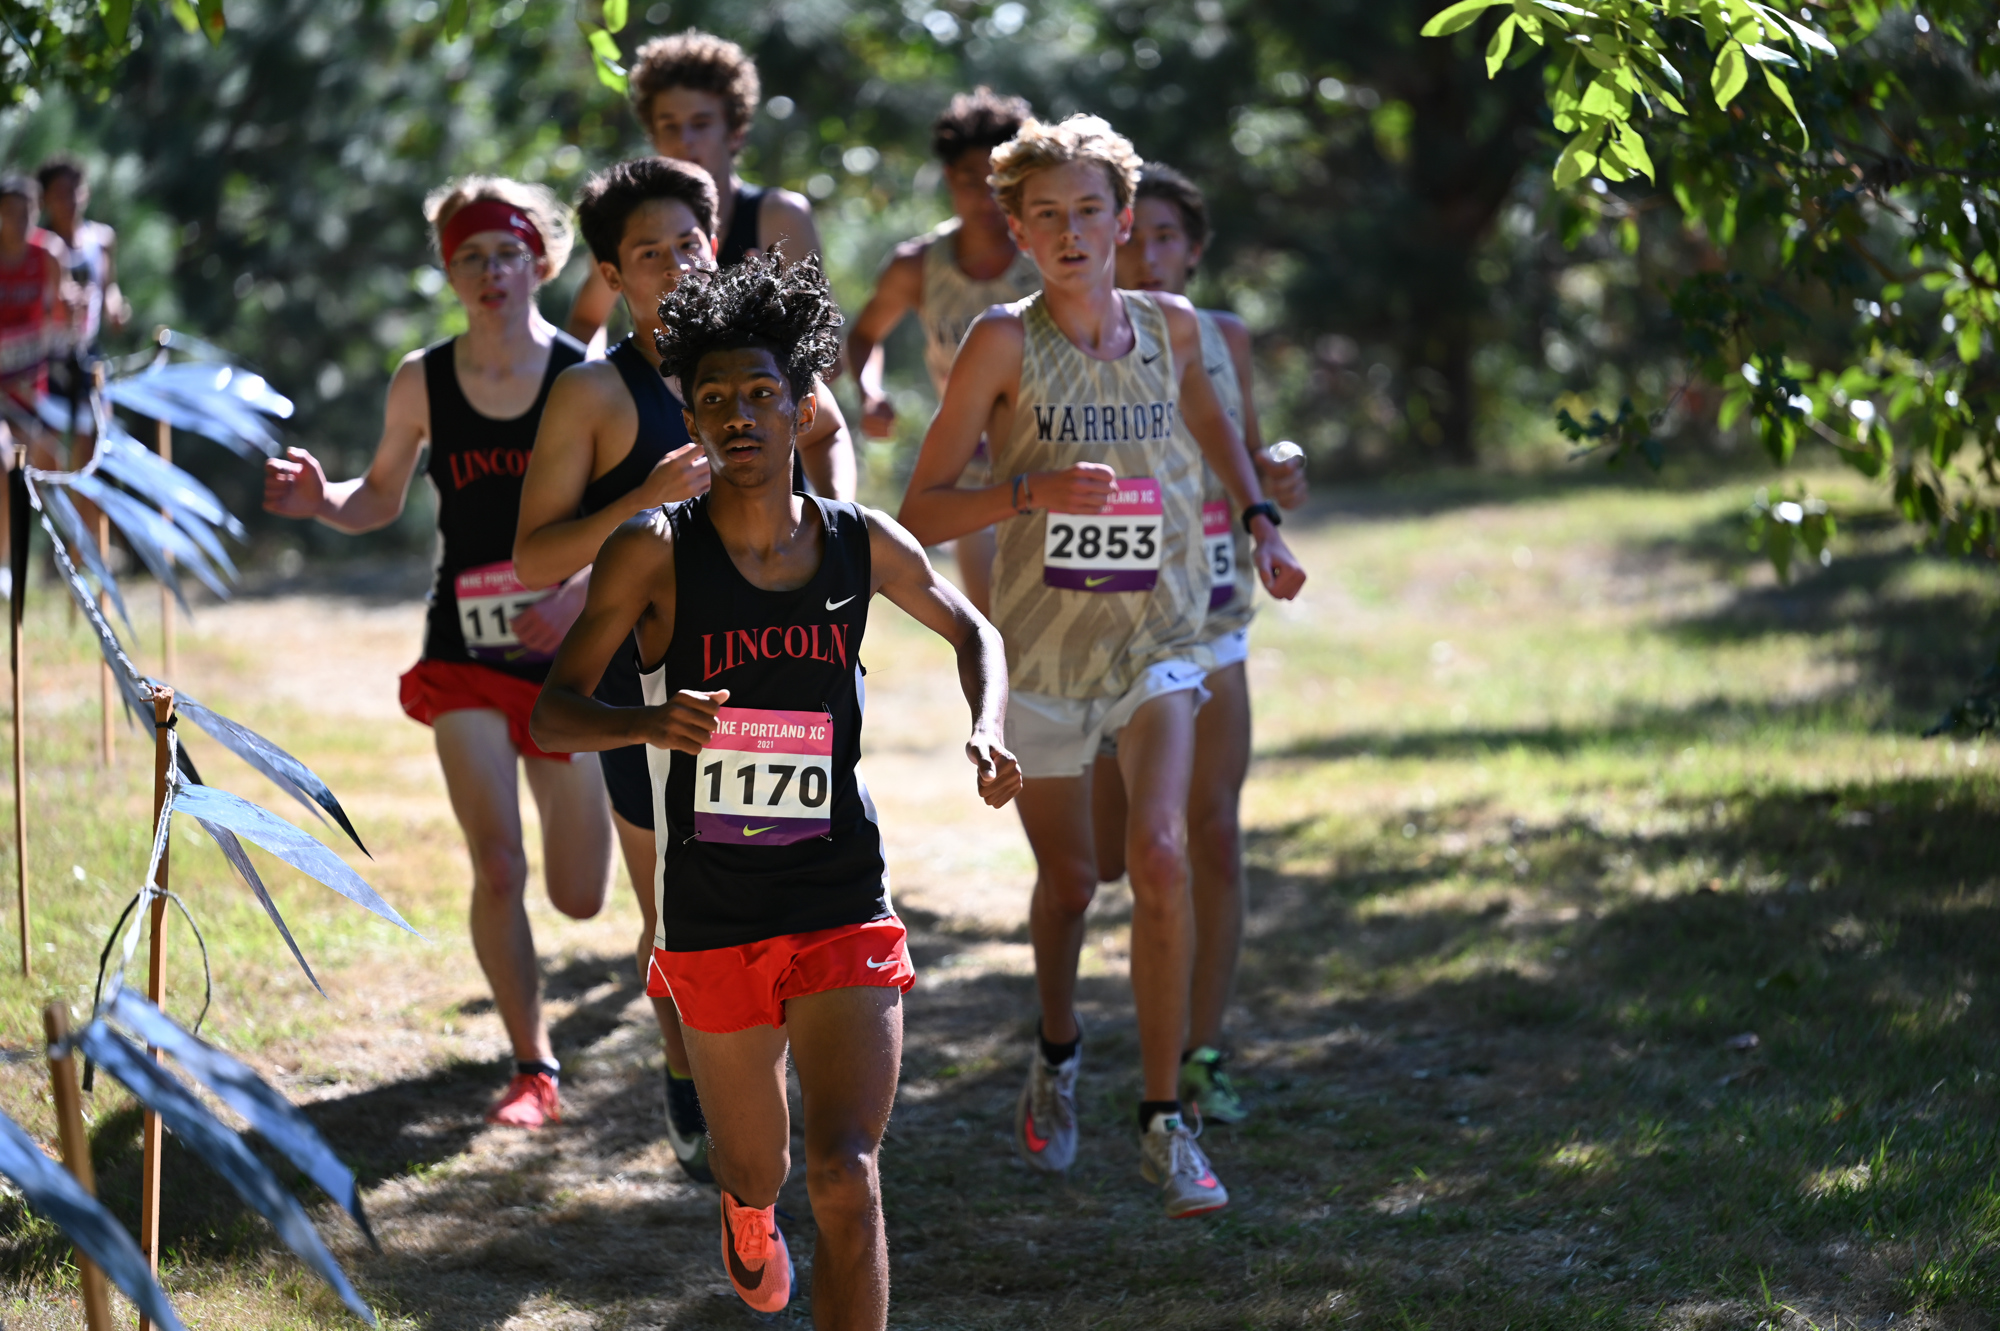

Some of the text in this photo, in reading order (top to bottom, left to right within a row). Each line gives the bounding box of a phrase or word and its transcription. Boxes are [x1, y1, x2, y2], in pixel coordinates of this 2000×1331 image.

[449, 446, 533, 490] LINCO
[1049, 523, 1157, 560] 2853
[701, 624, 849, 682] LINCOLN
[712, 721, 825, 740] IKE PORTLAND XC
[757, 740, 774, 749] 2021
[703, 760, 828, 808] 1170
